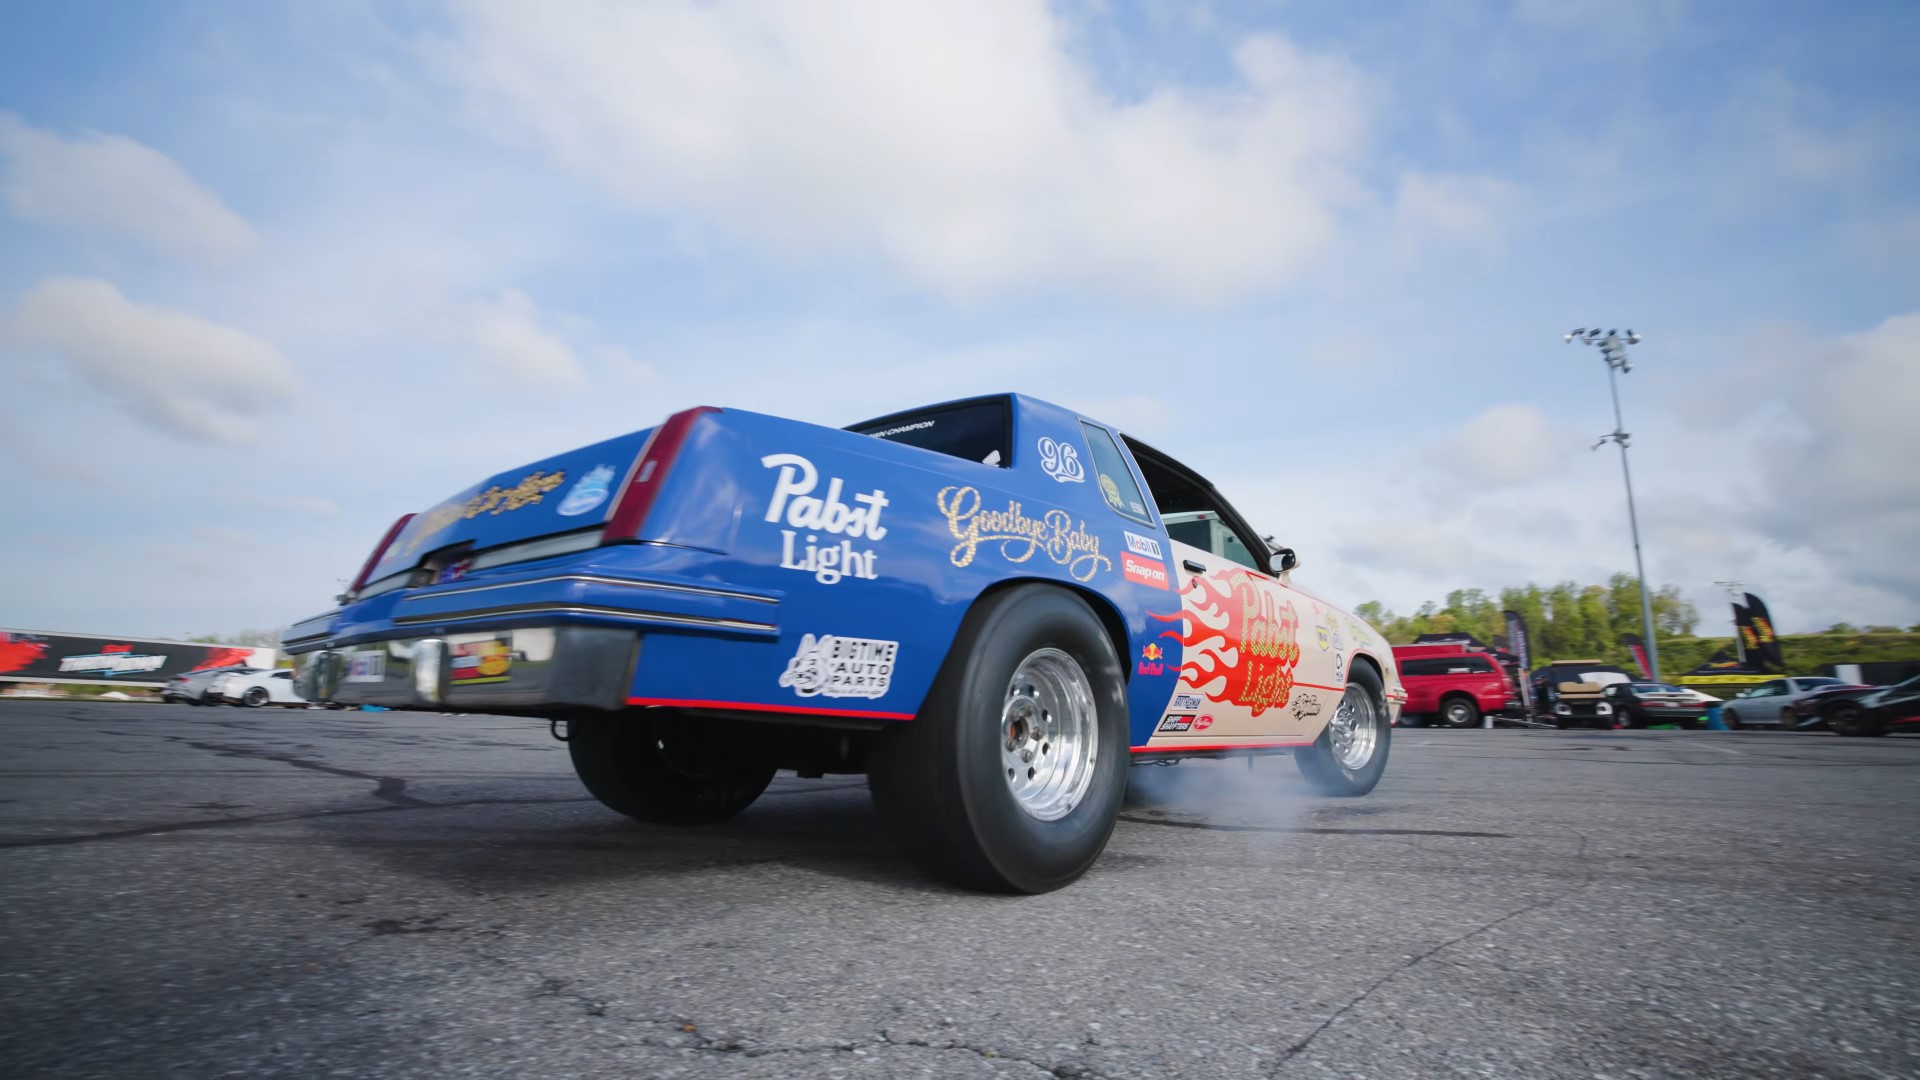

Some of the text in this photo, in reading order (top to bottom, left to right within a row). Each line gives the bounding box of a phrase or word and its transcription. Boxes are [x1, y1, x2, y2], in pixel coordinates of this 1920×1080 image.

[886, 419, 936, 436] CHAMPION
[1037, 436, 1086, 483] 96
[760, 453, 890, 541] Pabst
[937, 486, 1112, 582] Goodbye Baby
[1126, 534, 1153, 553] Mobil
[779, 529, 879, 585] Light
[1125, 559, 1165, 581] Snap-on
[834, 662, 890, 675] AUTO
[831, 675, 887, 688] PARTS
